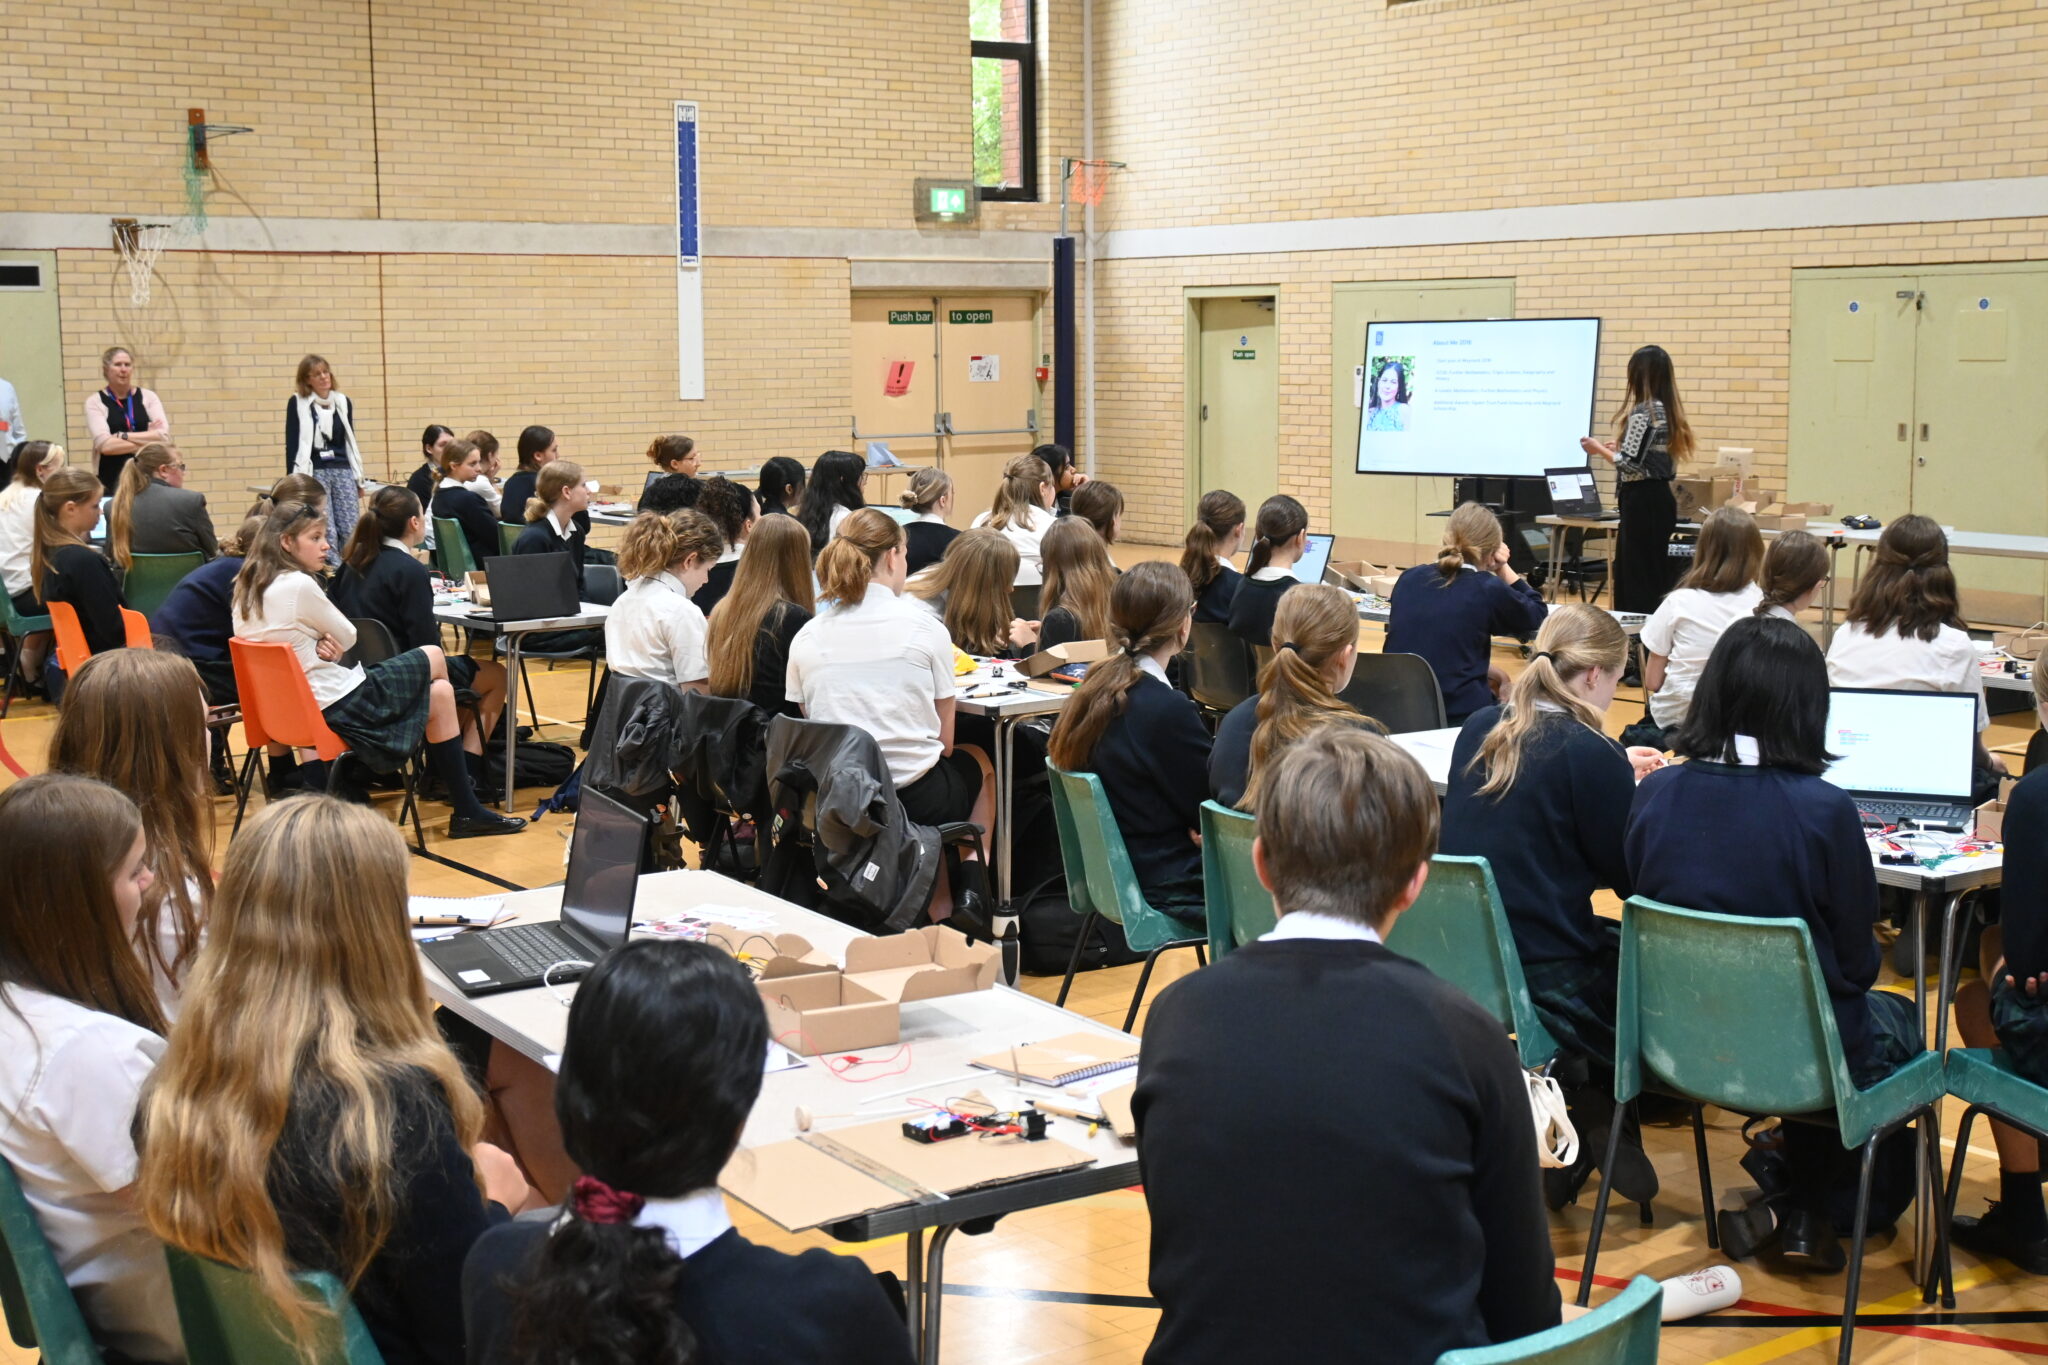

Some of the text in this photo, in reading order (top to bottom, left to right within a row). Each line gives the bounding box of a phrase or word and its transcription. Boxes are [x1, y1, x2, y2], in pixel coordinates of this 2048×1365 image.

[890, 311, 931, 321] Push bar
[952, 312, 991, 323] to open
